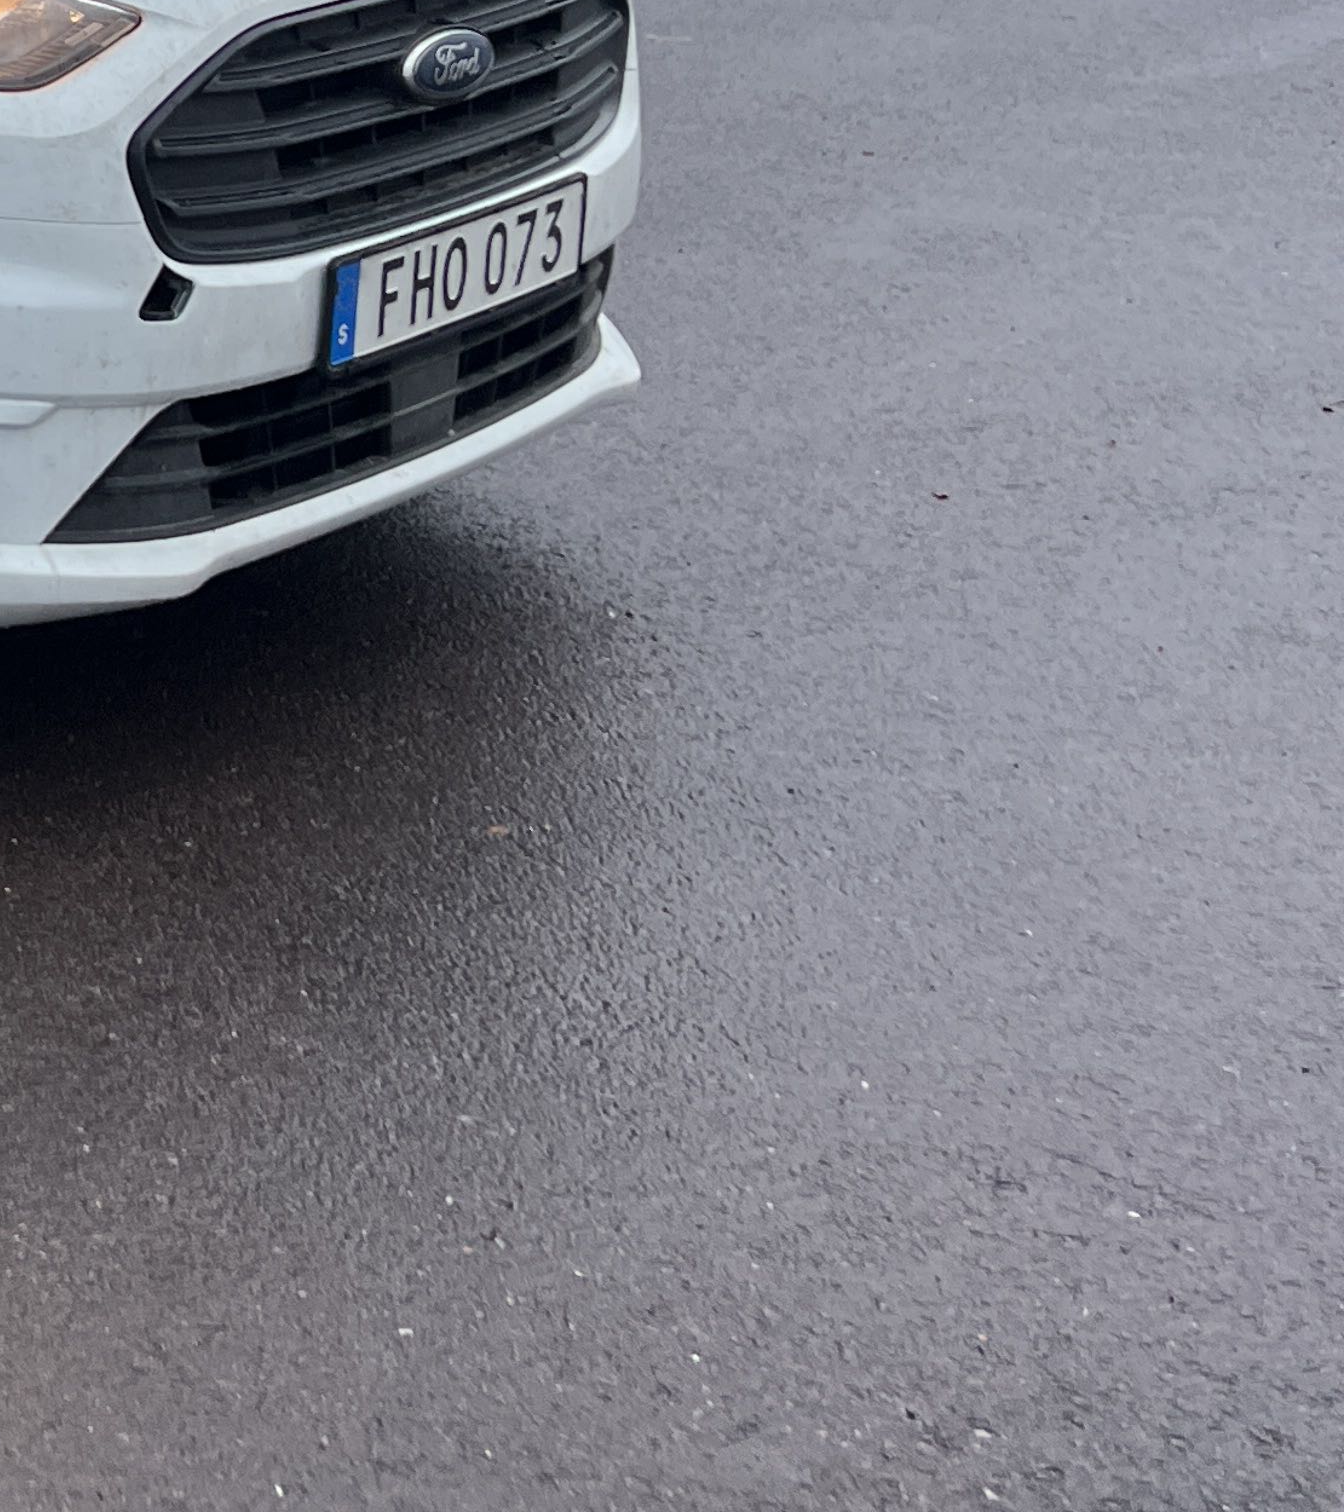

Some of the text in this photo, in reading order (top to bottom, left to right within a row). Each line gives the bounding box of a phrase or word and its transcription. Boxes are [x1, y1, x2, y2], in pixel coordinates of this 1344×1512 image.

[434, 41, 480, 86] Ford
[377, 198, 564, 337] FHO 073
